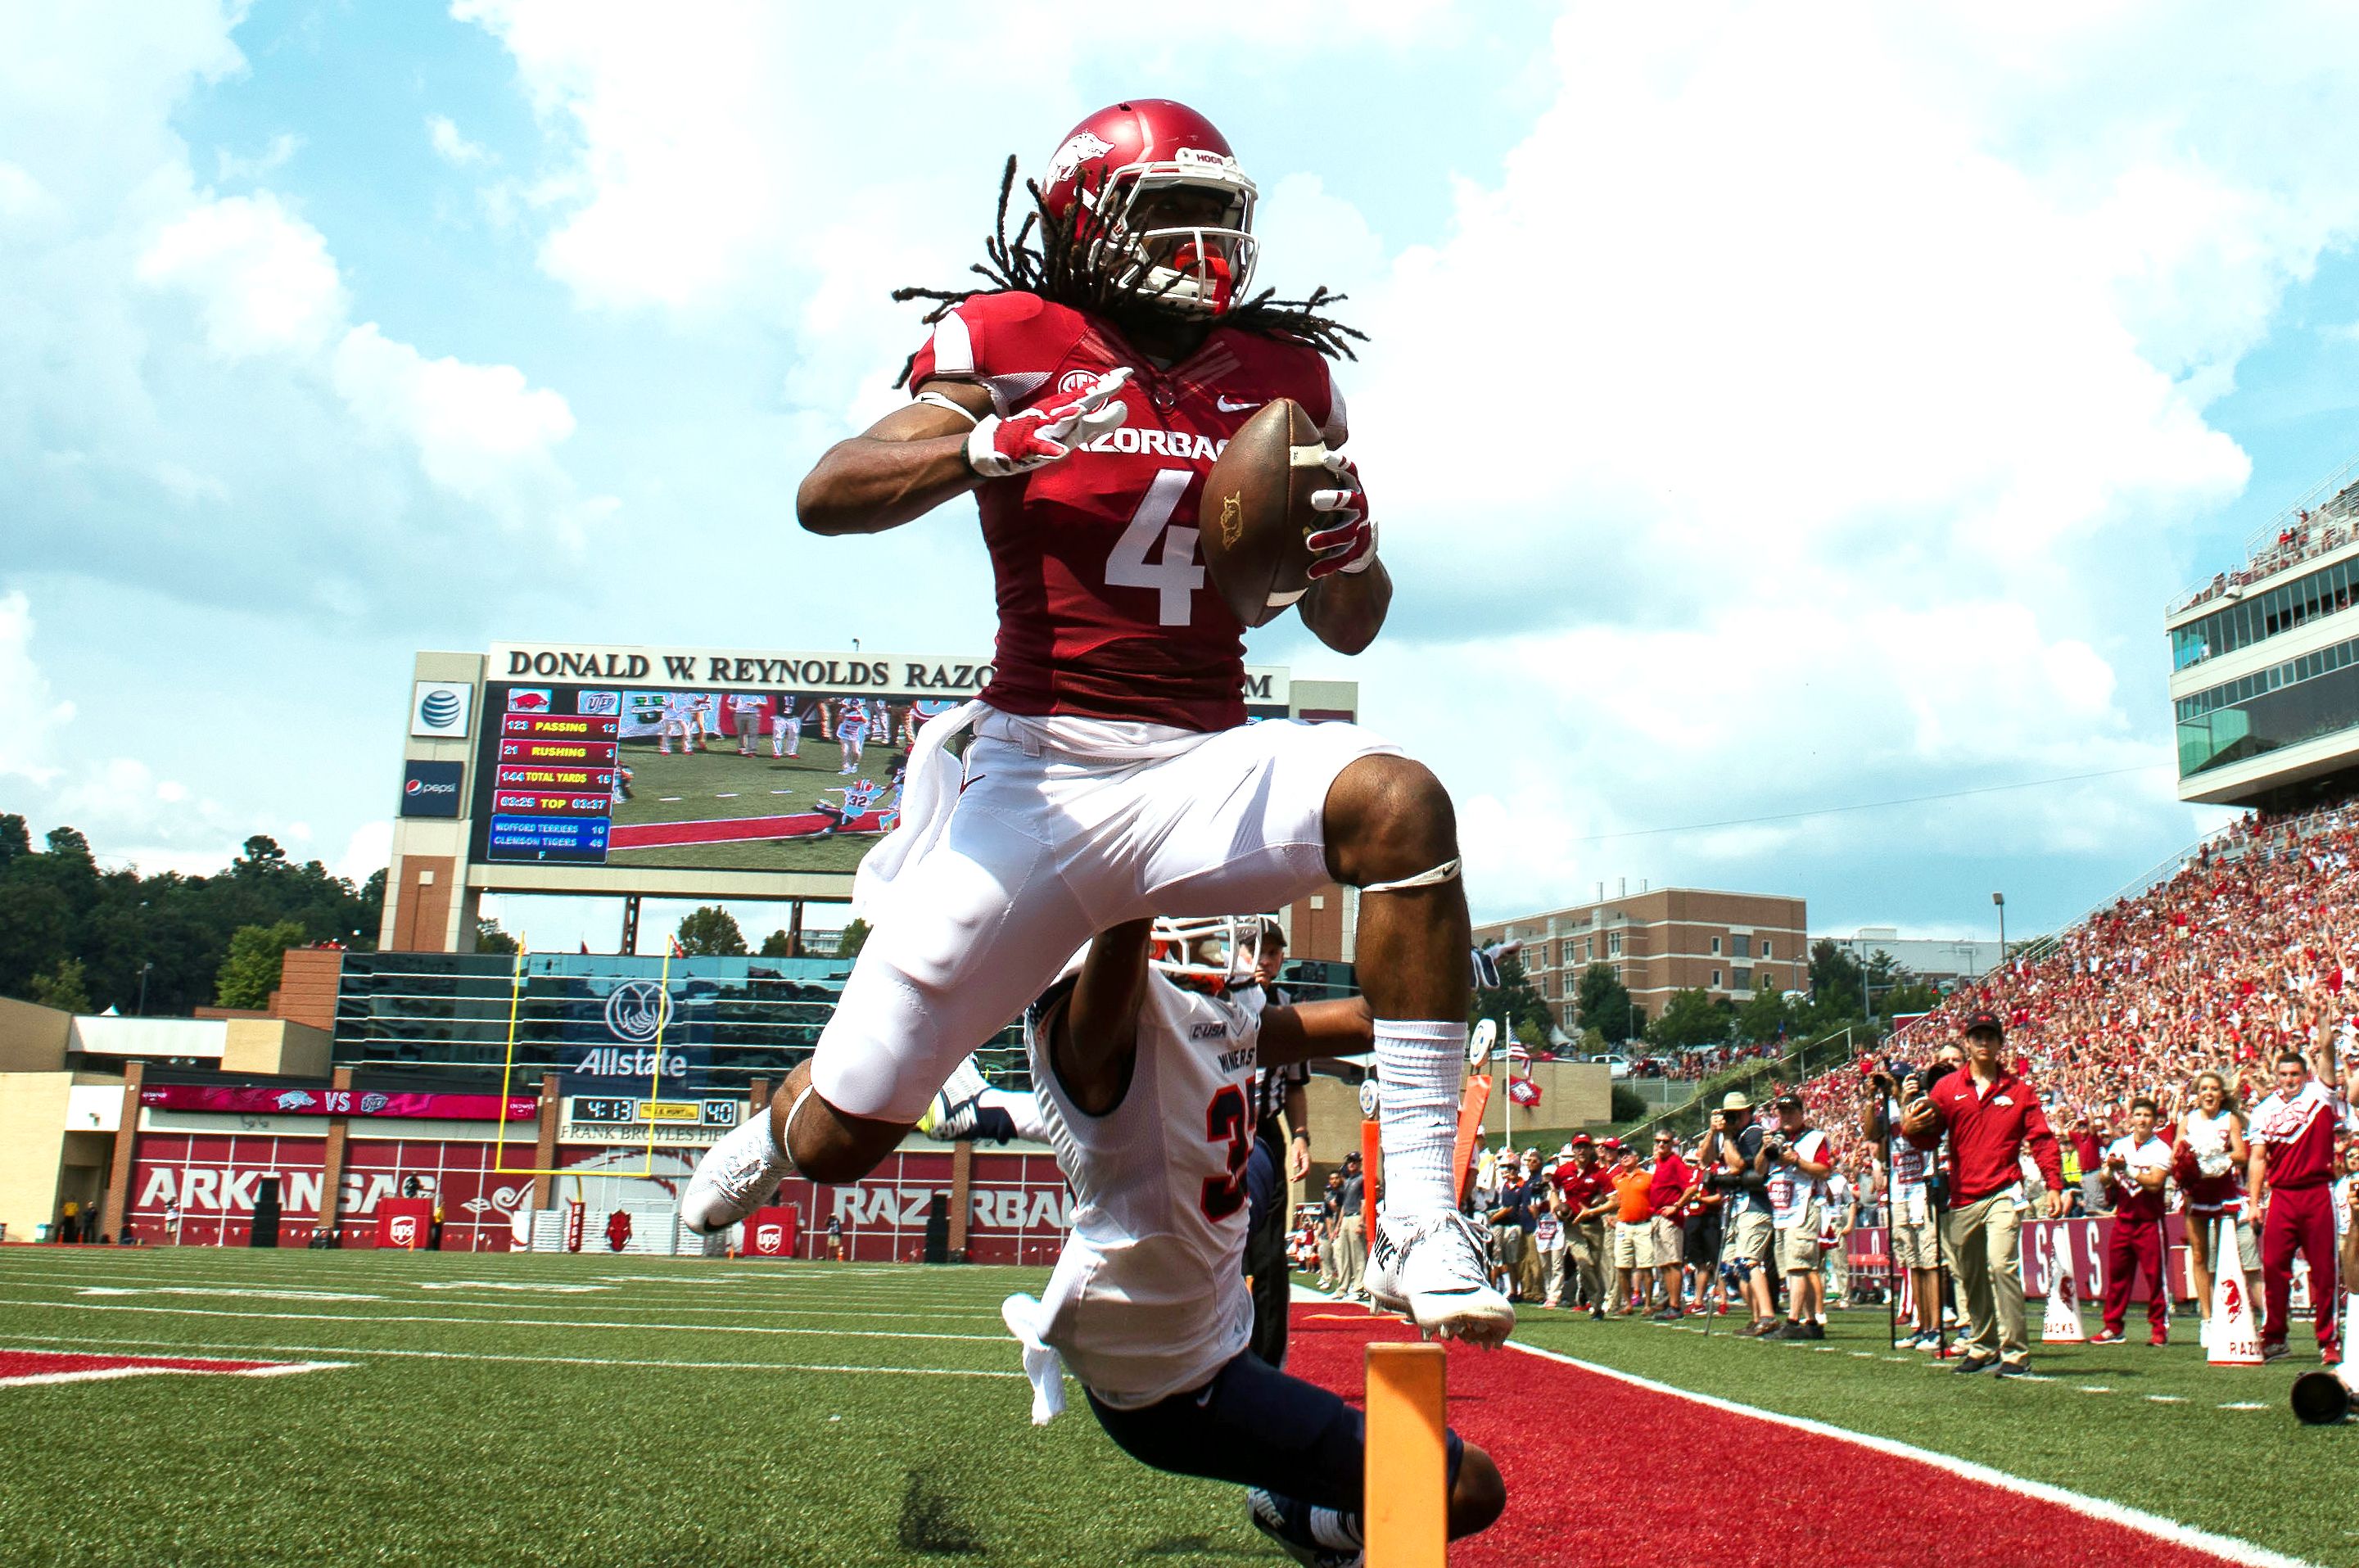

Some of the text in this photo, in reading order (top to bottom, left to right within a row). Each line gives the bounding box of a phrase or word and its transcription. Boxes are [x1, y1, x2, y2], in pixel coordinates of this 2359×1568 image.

[1105, 469, 1205, 626] 4
[508, 651, 650, 679] DONALD
[664, 656, 696, 680] W.
[708, 657, 888, 686] REYNOLDS
[535, 721, 588, 733] PASSING
[531, 747, 586, 757] RUSHING
[526, 772, 554, 782] TOTAL
[557, 774, 587, 783] YARDS
[422, 783, 455, 794] pepsi
[540, 798, 567, 809] TOP
[575, 1048, 688, 1078] Allstate
[1218, 1047, 1255, 1074] MINERS
[325, 1091, 351, 1112] VS
[588, 1100, 633, 1120] 4:13
[707, 1102, 733, 1123] 40
[560, 1126, 614, 1139] FRANK
[393, 1225, 414, 1240] ups
[759, 1232, 780, 1249] ups
